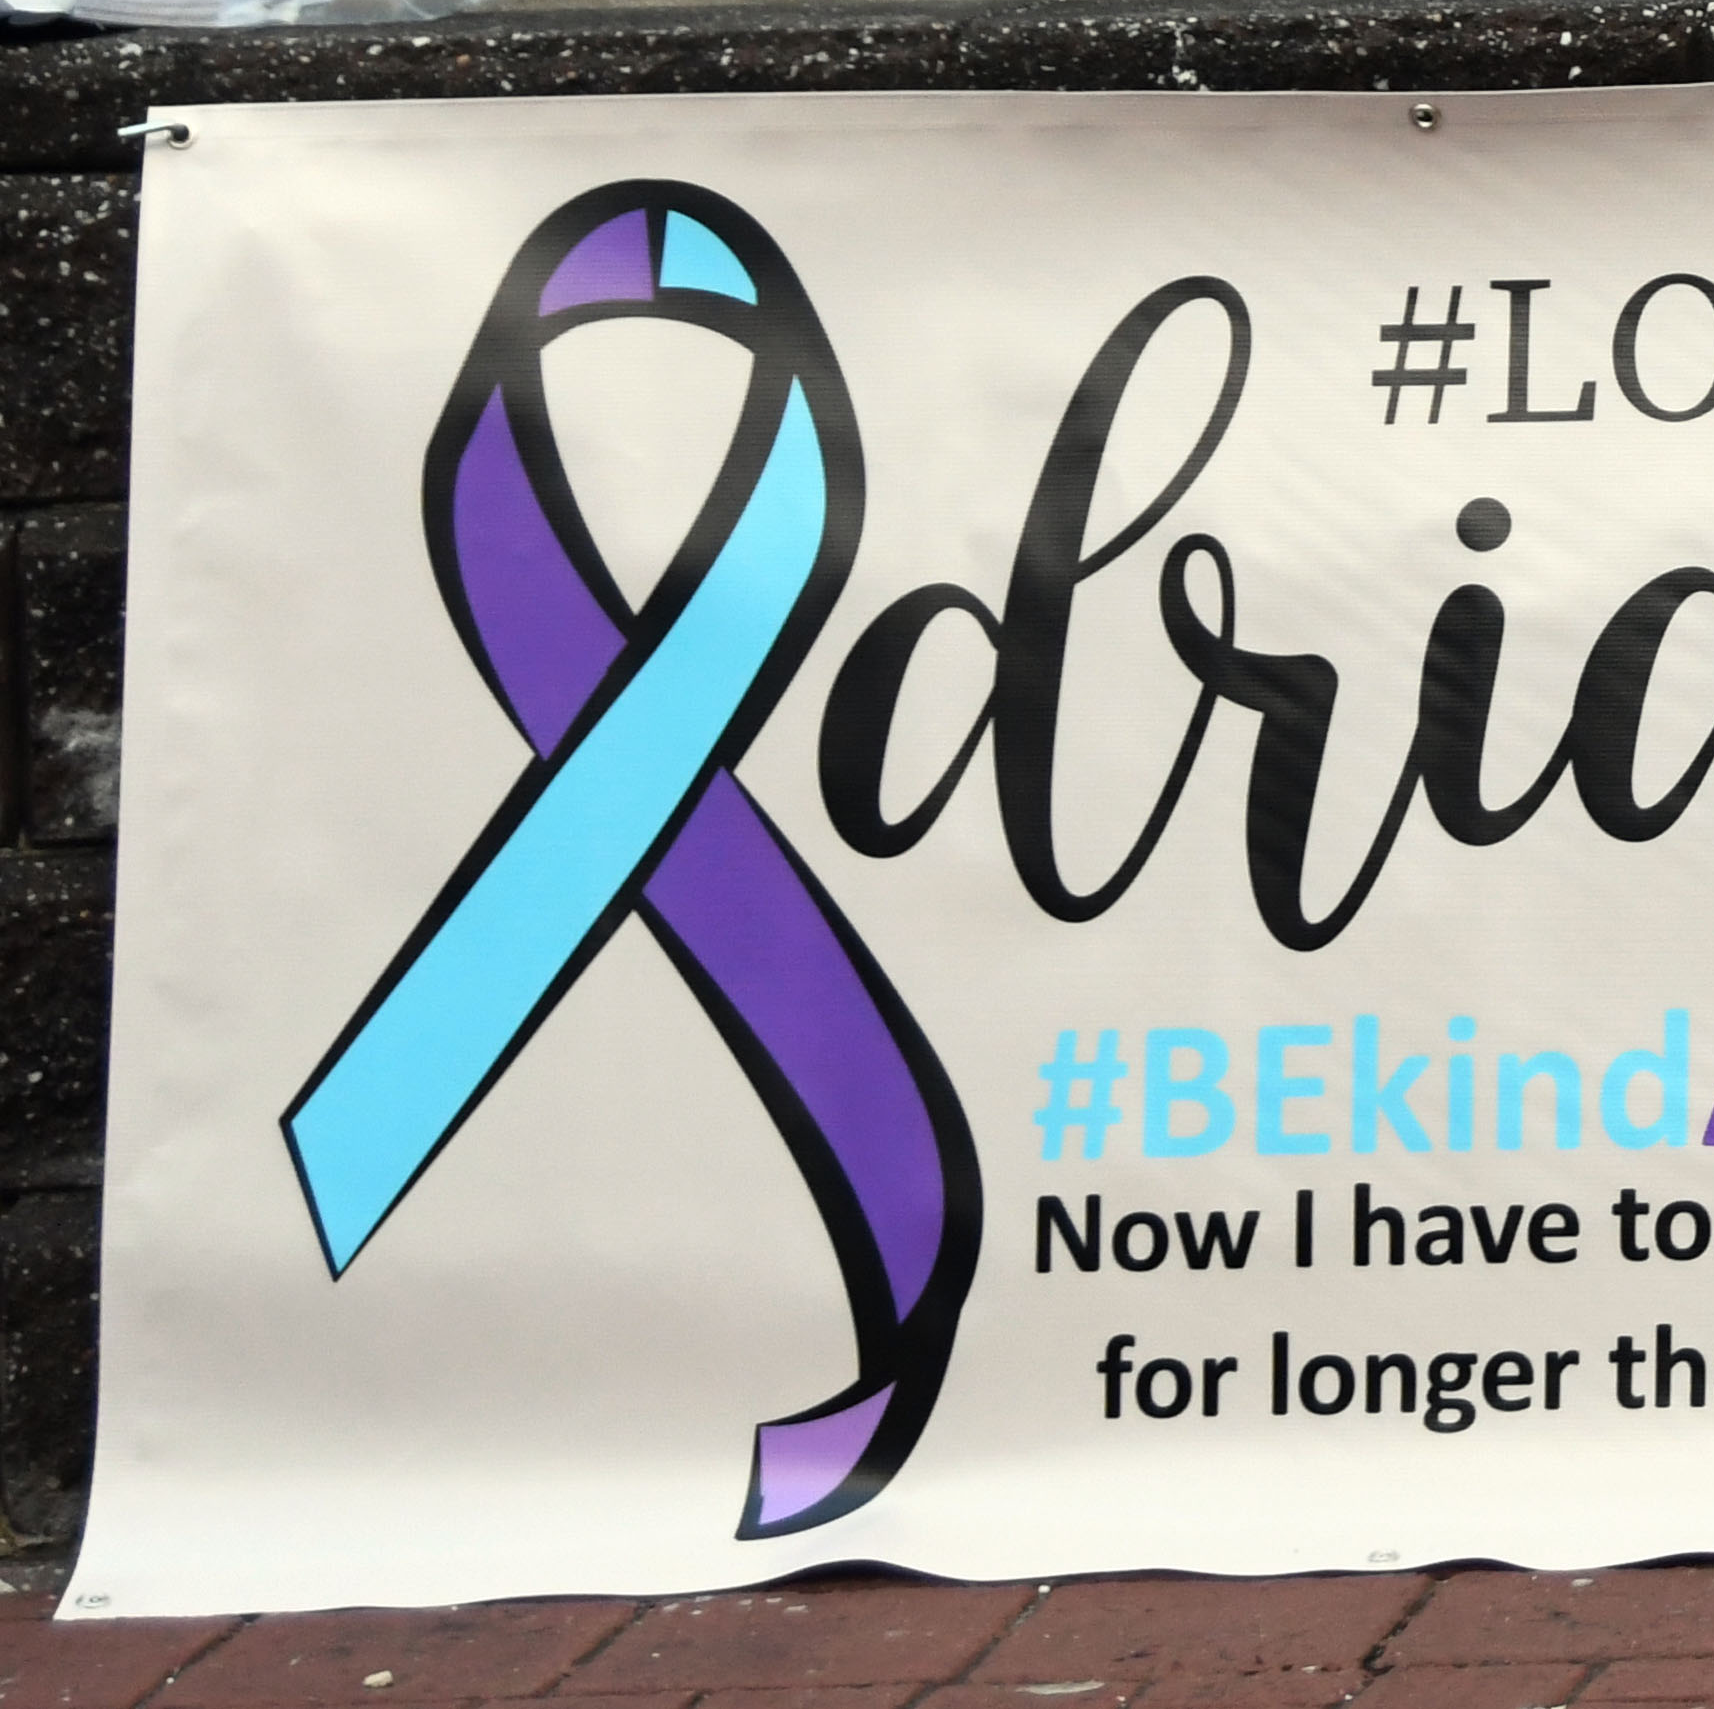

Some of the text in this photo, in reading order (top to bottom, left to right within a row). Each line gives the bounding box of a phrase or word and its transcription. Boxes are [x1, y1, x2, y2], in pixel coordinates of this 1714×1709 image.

[1035, 1193, 1261, 1274] Now
[1295, 1189, 1314, 1269] I
[1353, 1182, 1580, 1267] have
[1611, 1188, 1712, 1263] to
[1096, 1333, 1238, 1421] for
[1271, 1331, 1580, 1434] longer
